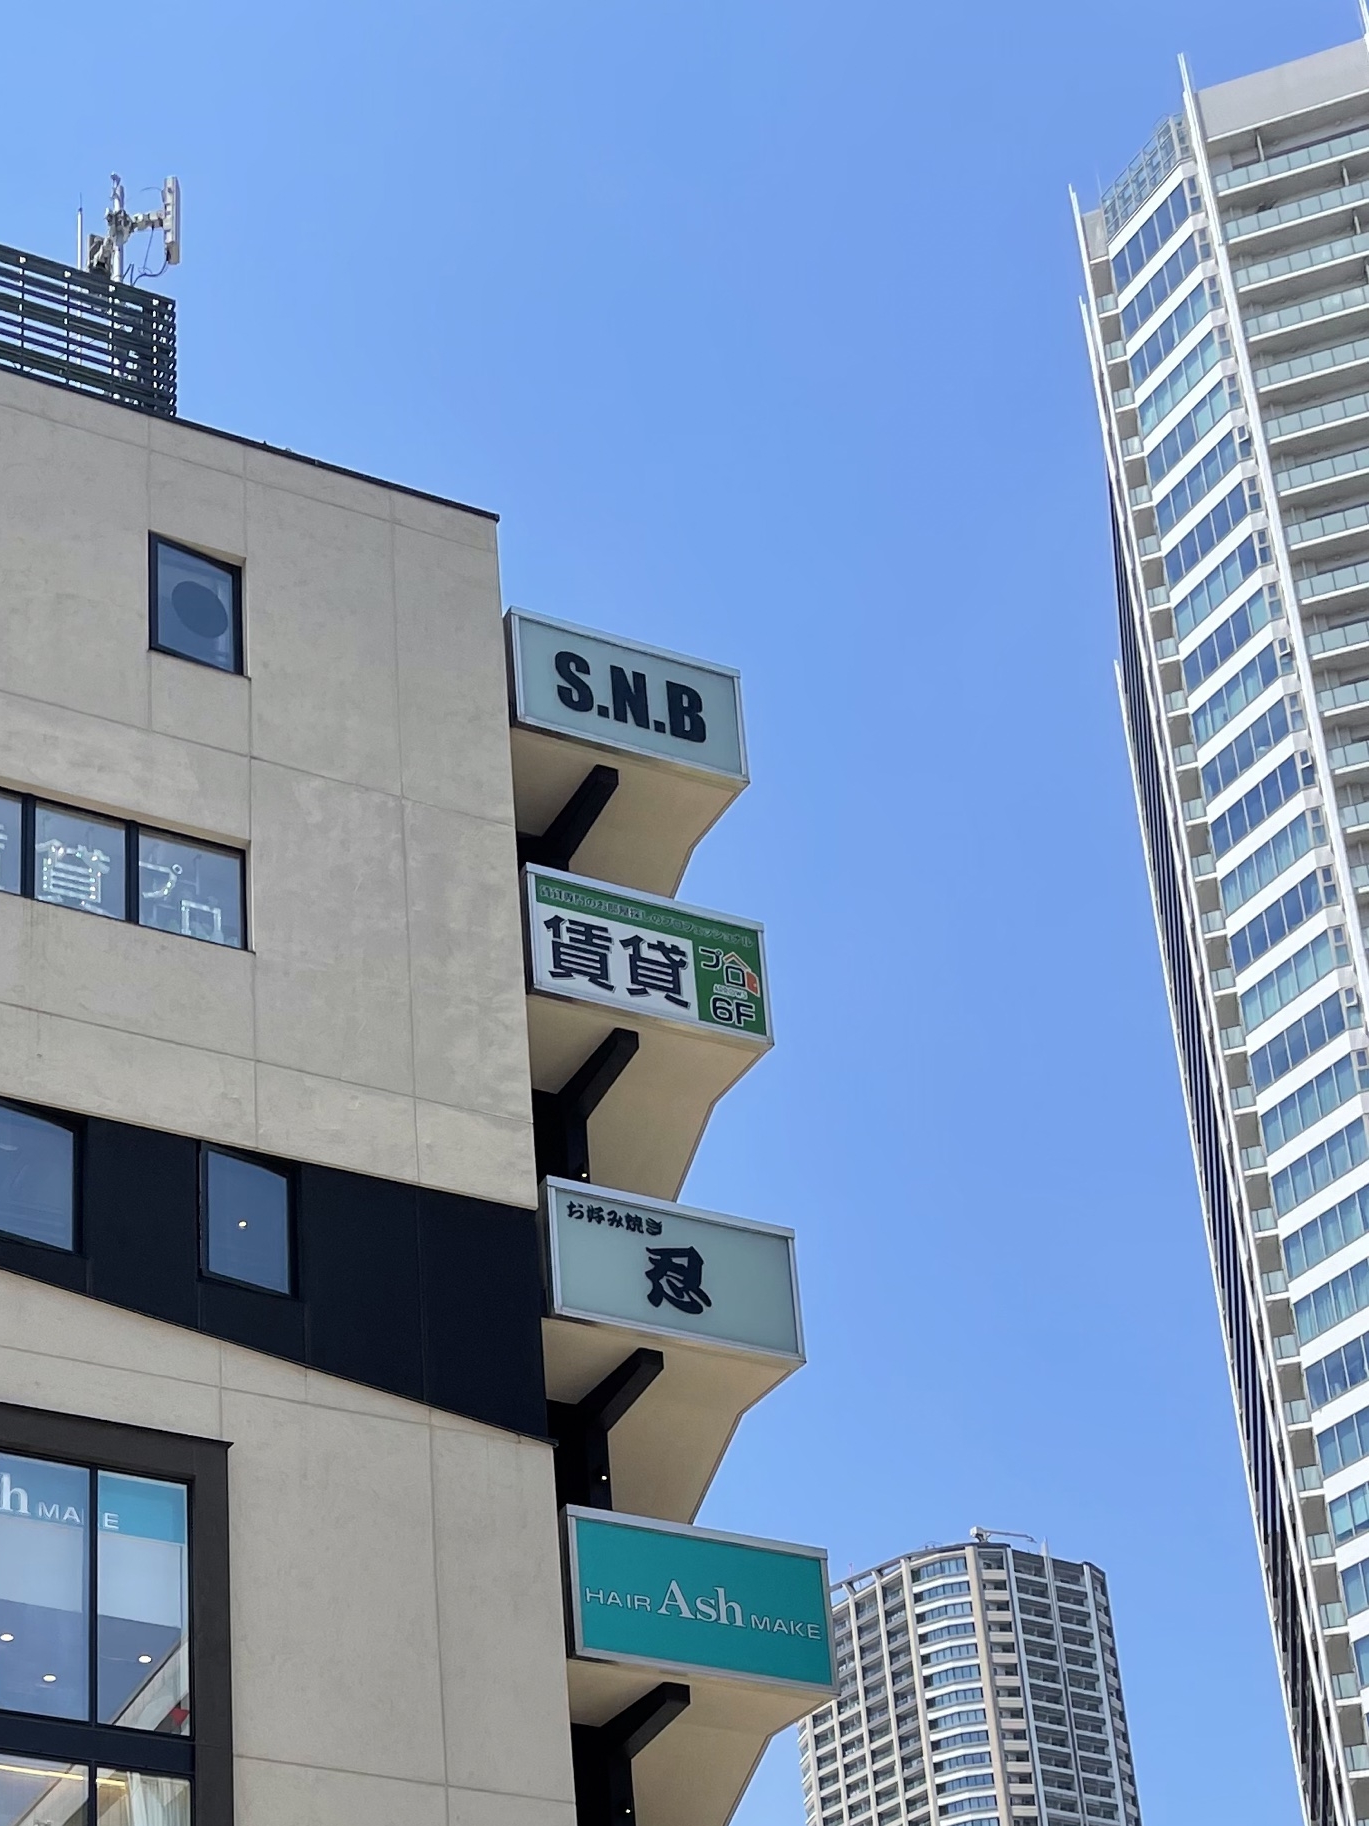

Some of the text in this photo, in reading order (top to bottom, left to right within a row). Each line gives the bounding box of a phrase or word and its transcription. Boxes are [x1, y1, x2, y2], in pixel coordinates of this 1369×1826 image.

[554, 651, 707, 743] S.N.B
[543, 914, 691, 1010] 賃貸
[698, 945, 748, 989] プロ
[710, 996, 756, 1027] 6F
[713, 984, 748, 1000] ARROWS
[565, 1200, 663, 1236] お好み焼き
[645, 1245, 712, 1315] 忍
[38, 1501, 119, 1529] MAE
[585, 1579, 822, 1641] HAIR Ash MAKE
